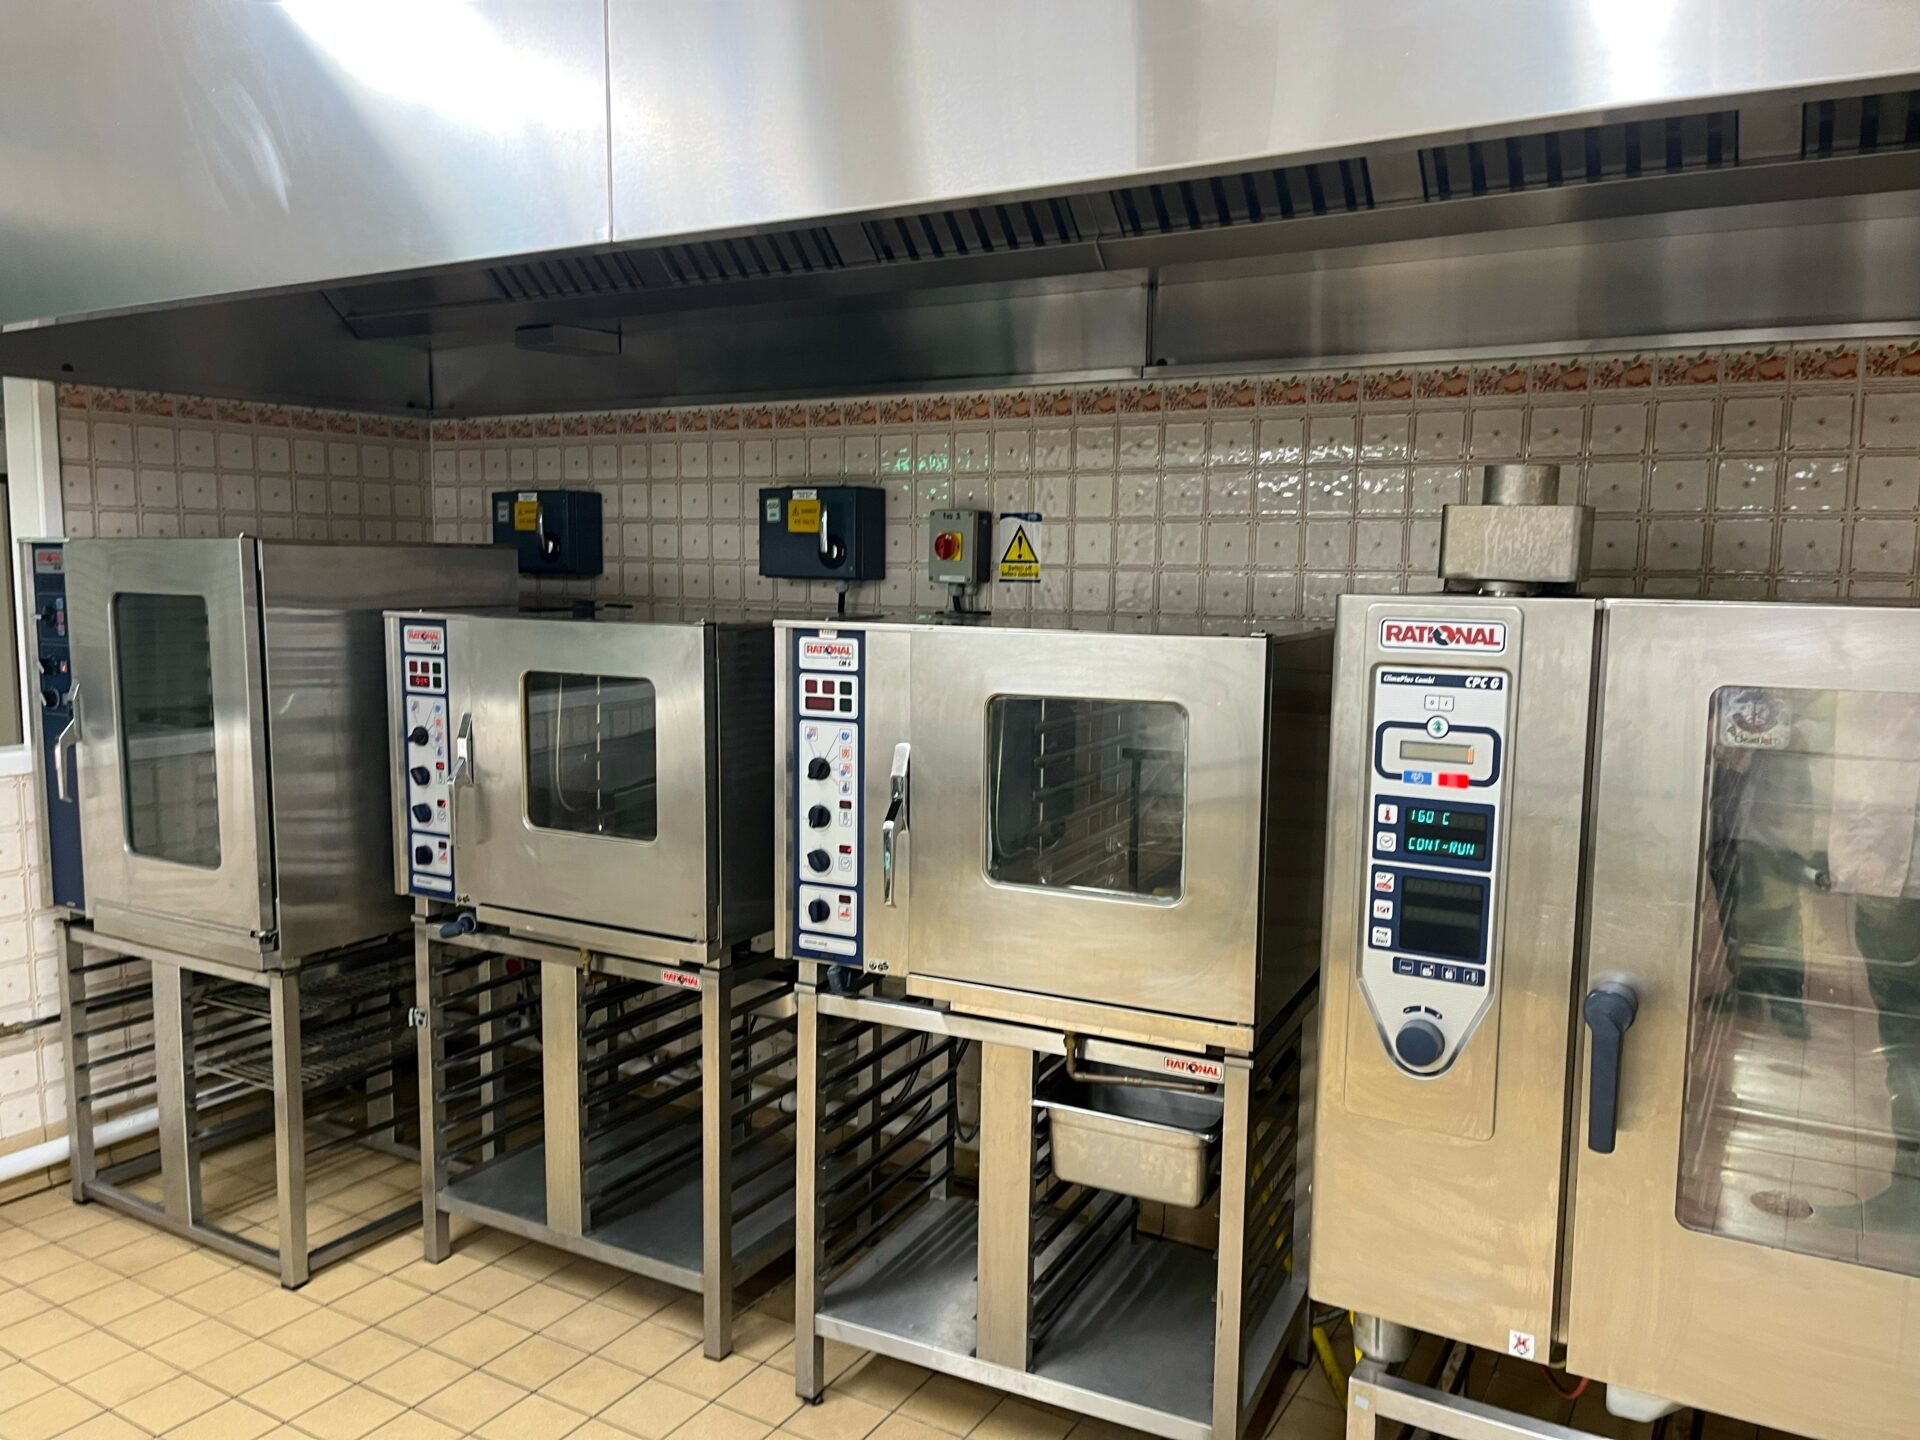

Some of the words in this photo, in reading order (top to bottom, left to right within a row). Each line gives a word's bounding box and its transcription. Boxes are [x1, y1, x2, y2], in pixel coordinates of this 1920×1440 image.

[1385, 624, 1501, 645] RATIONAL
[806, 644, 851, 655] RATIONAL
[1465, 676, 1489, 688] CPC
[1411, 809, 1435, 824] 160
[1442, 812, 1451, 826] C
[1408, 837, 1475, 856] CONT-RUN
[1166, 1058, 1220, 1077] RATIONAL
